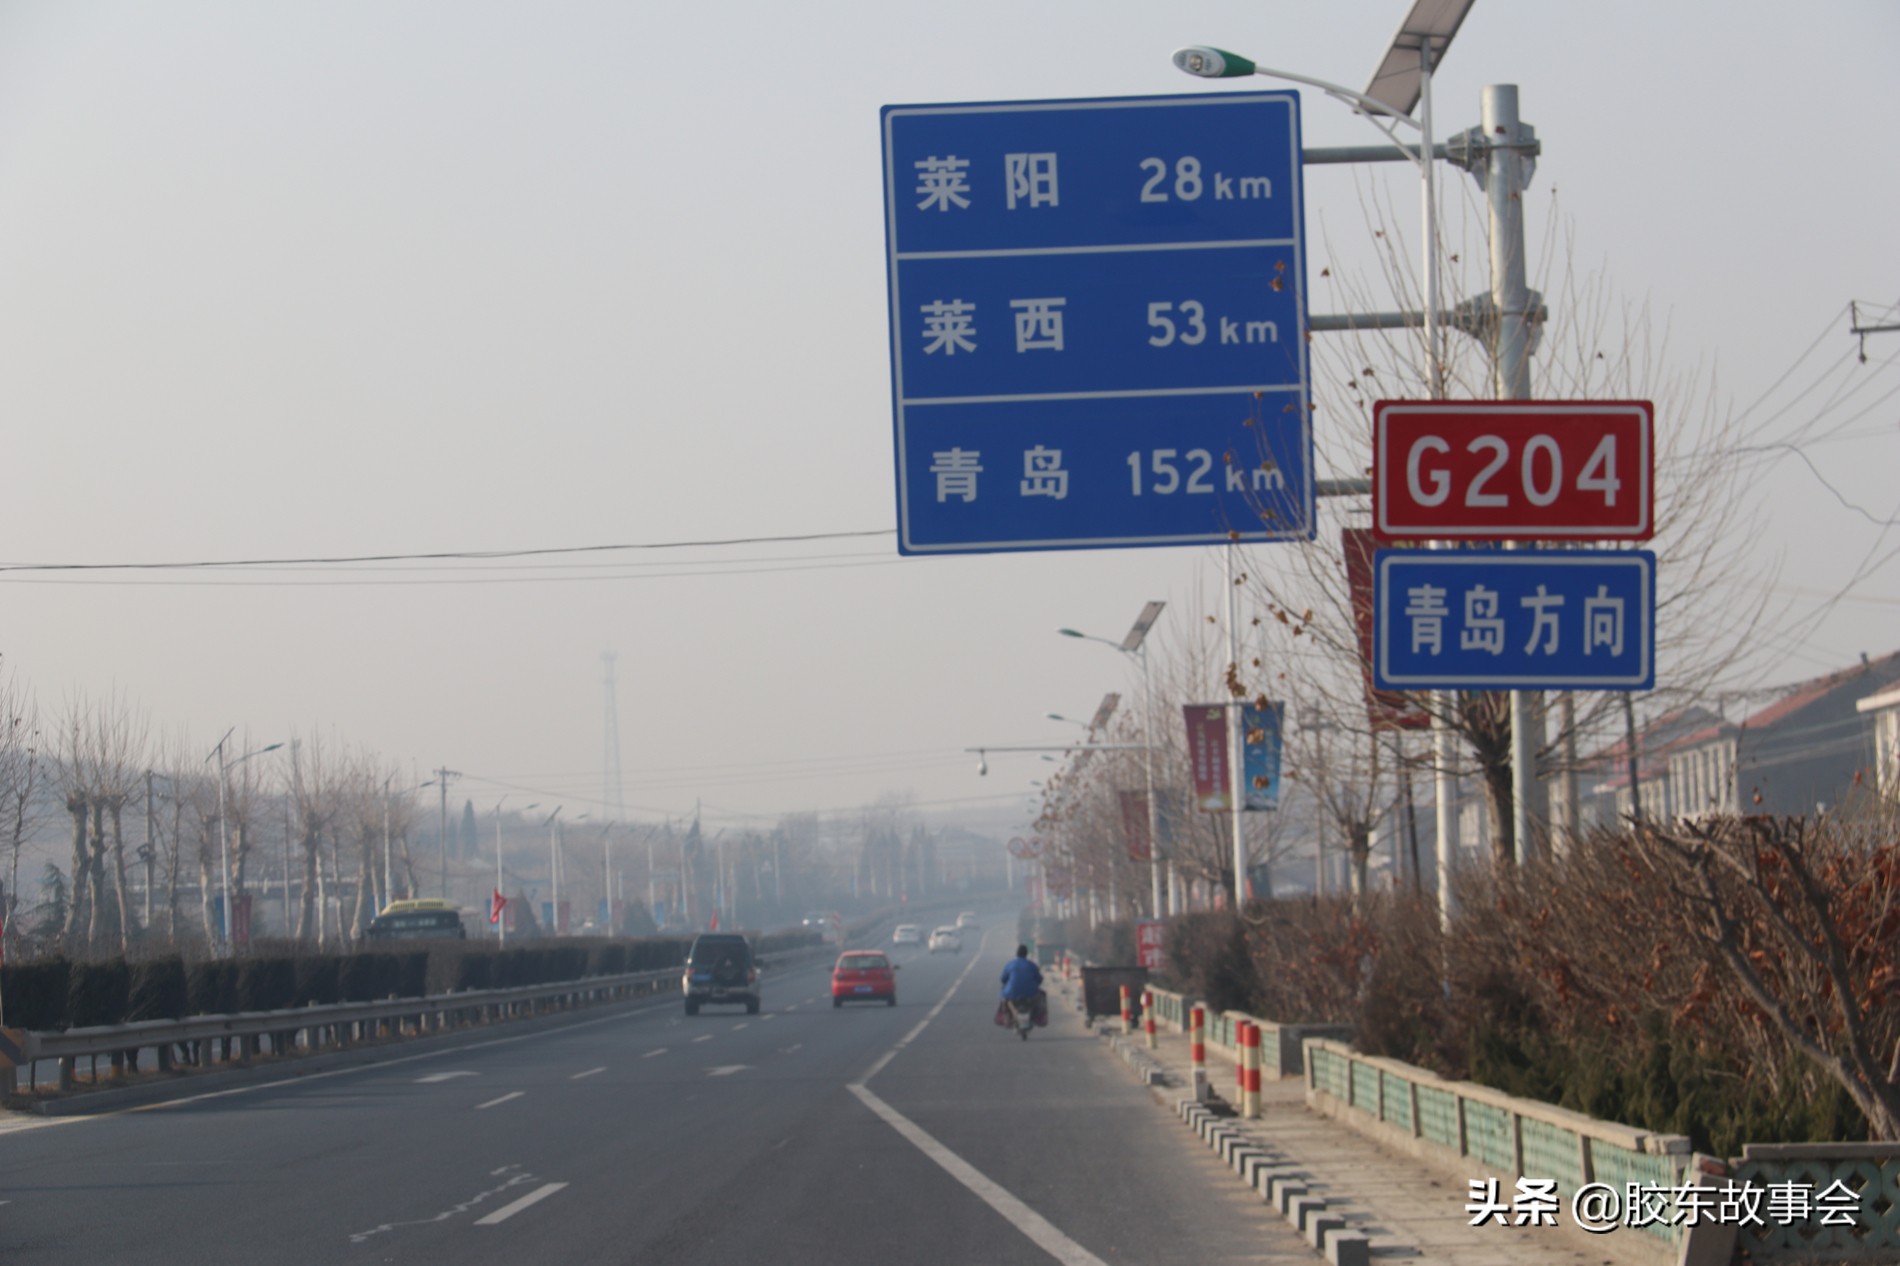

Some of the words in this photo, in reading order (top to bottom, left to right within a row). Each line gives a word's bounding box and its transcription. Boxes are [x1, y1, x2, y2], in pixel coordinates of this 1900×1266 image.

[914, 152, 1059, 212] 莱阳
[920, 297, 1067, 355] 莱西
[929, 445, 1069, 503] 青岛
[1406, 434, 1621, 507] G204
[1405, 584, 1625, 656] 青岛方向
